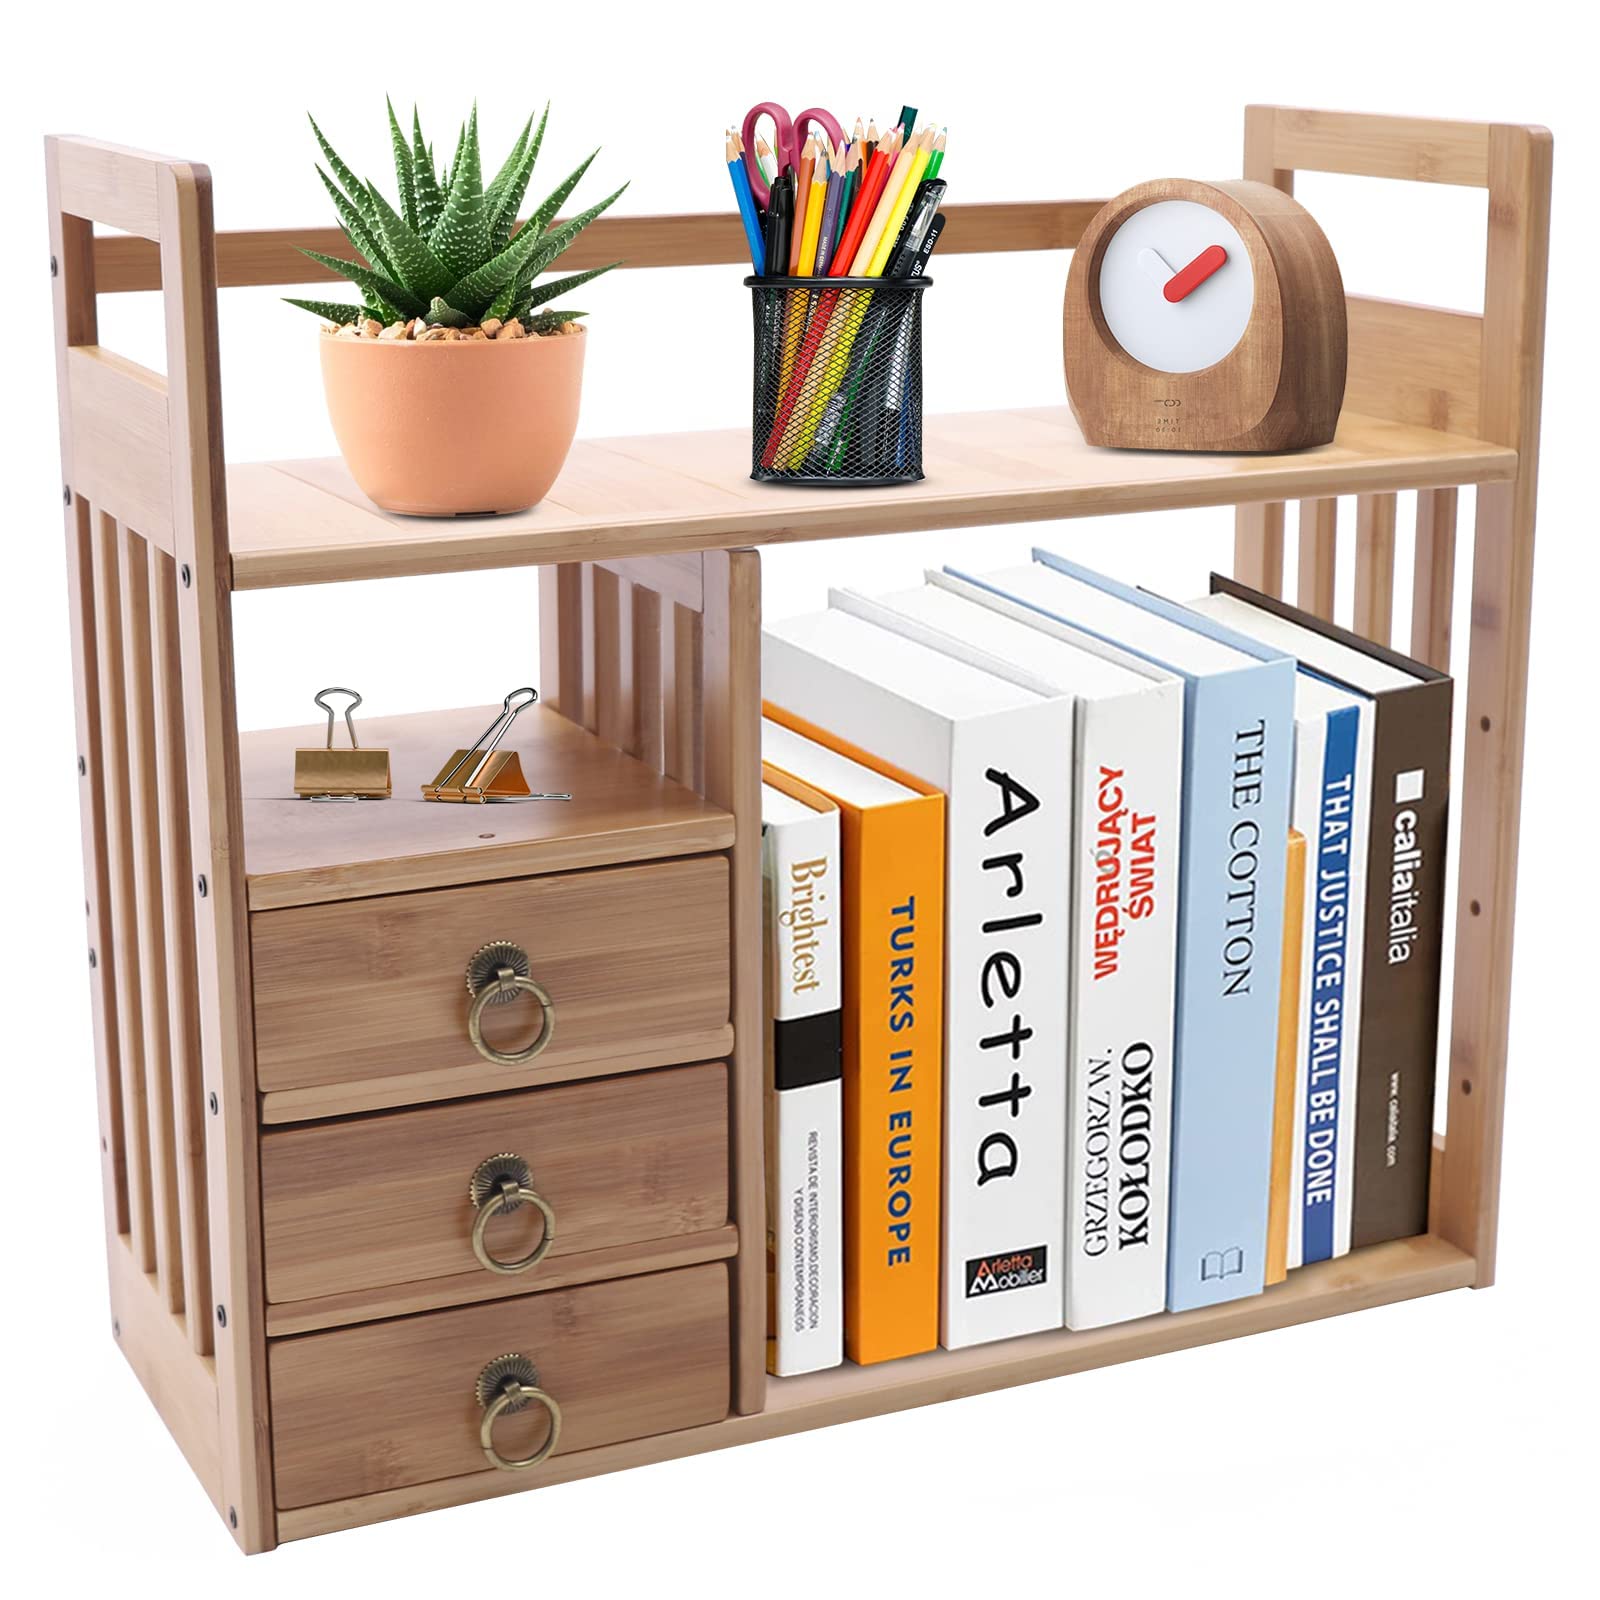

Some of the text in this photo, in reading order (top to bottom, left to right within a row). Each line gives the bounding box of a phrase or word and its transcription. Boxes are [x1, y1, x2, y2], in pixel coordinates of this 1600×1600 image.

[923, 229, 938, 254] ESD-11
[779, 856, 829, 995] Brightest
[1094, 766, 1128, 980] WĘDRUJĄCY
[1122, 812, 1156, 920] ŚWIAT
[1222, 719, 1266, 998] THE COTTON
[1388, 809, 1423, 964] caliaitalia
[977, 767, 1044, 1187] Arletta
[1305, 774, 1352, 1207] THAT JUSTICE SHALL BE DONE
[807, 1131, 819, 1173] REVISTA
[887, 895, 915, 1267] TURKS IN EUROPE
[1083, 1048, 1112, 1257] GRZEGORZ W.
[1118, 1042, 1153, 1251] KOŁODKO
[794, 1187, 804, 1195] Y
[807, 1176, 819, 1190] DE
